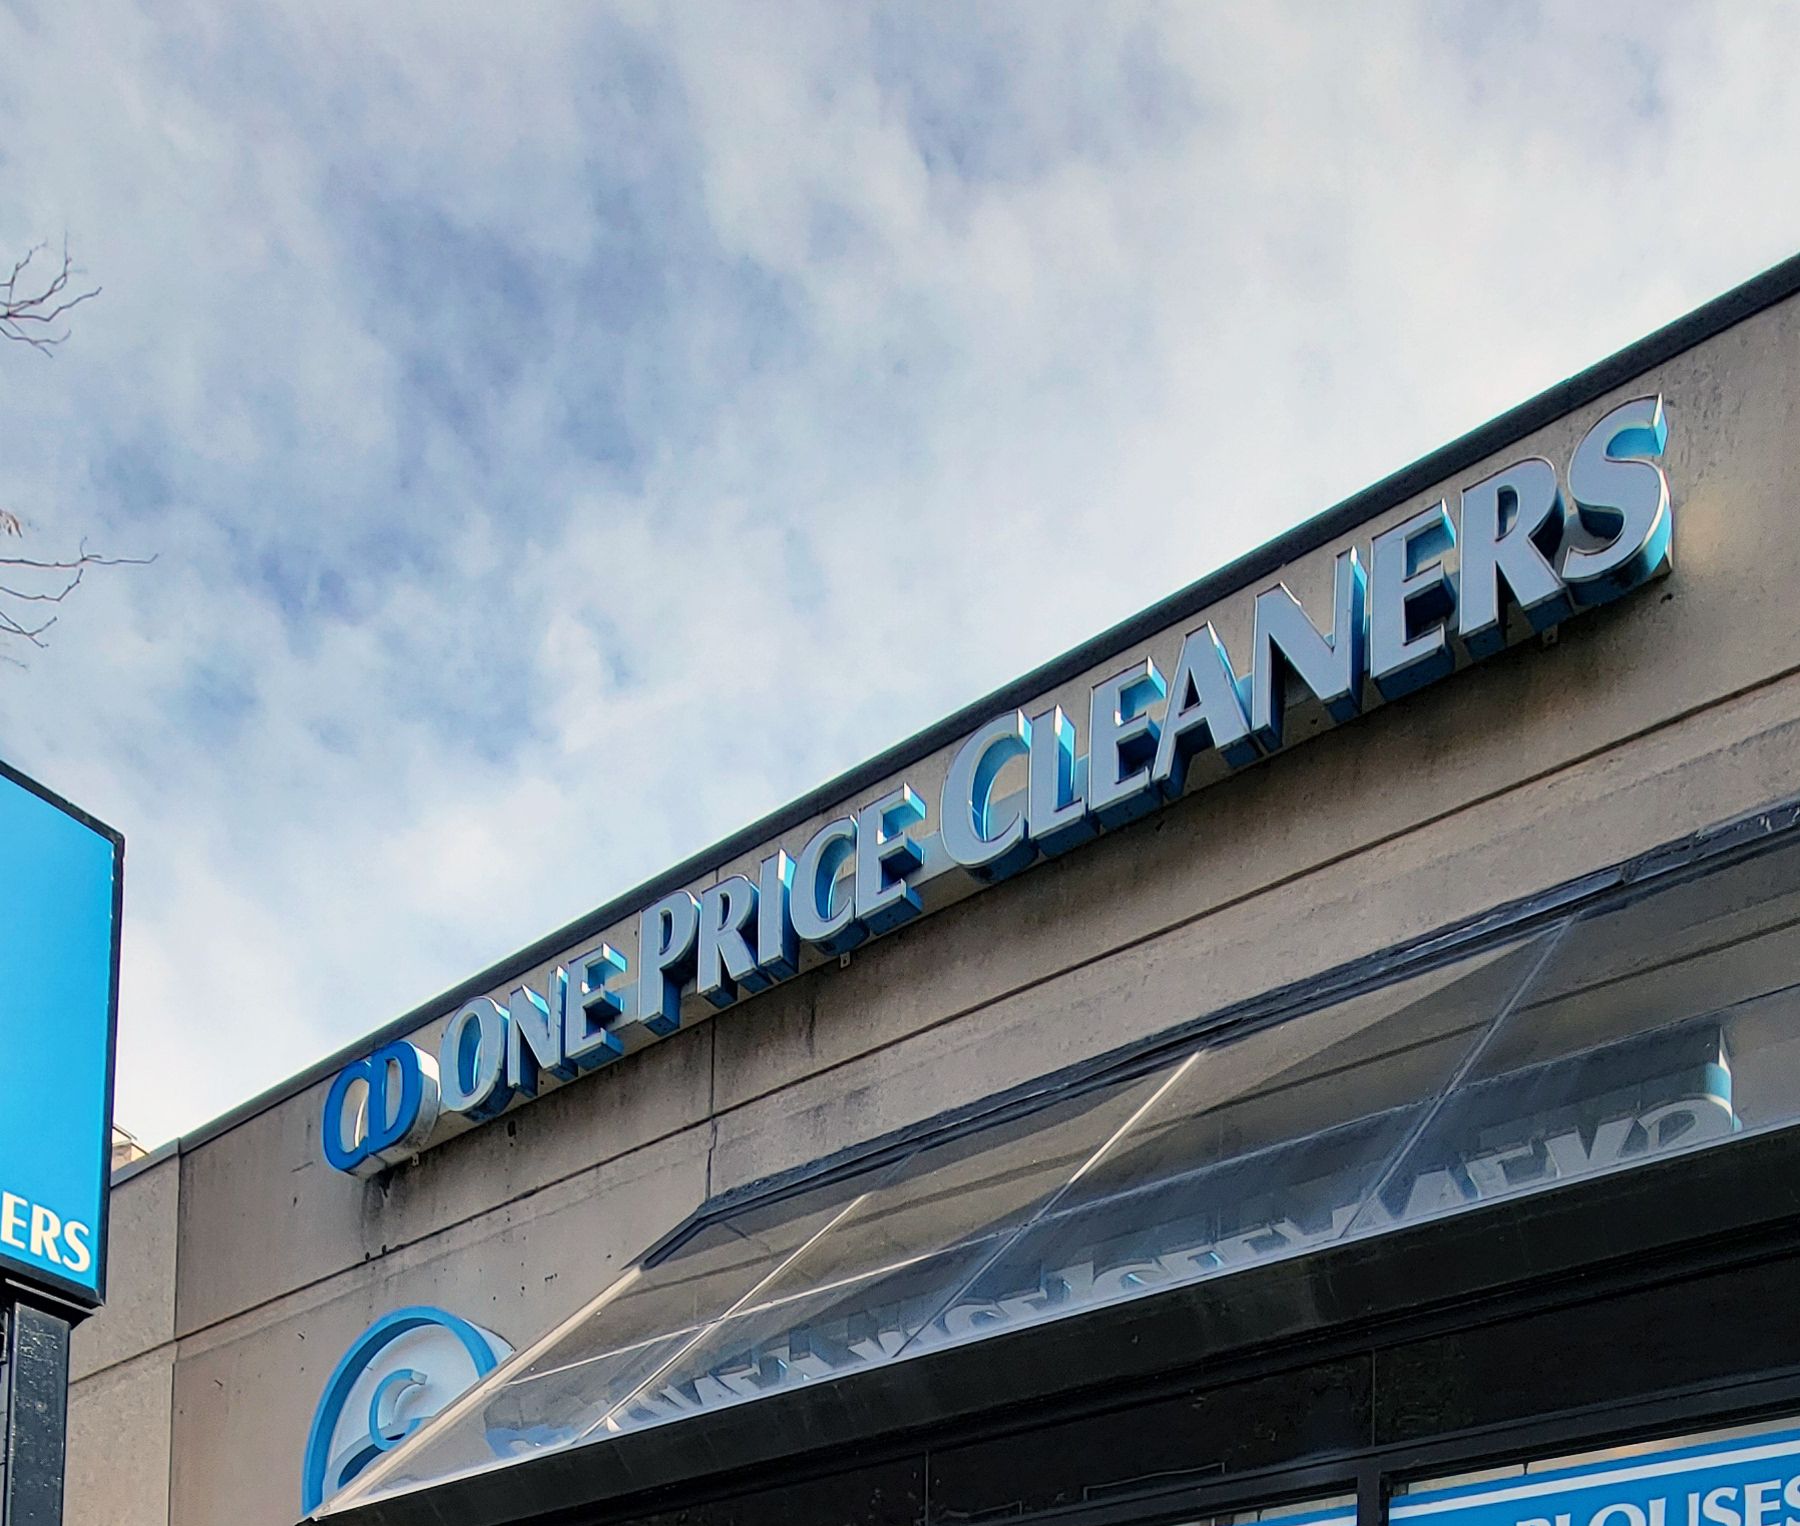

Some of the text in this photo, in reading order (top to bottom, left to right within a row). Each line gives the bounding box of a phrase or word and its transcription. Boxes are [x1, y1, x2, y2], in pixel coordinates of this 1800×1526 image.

[440, 943, 627, 1121] ONE
[637, 783, 926, 1036] PRICE
[940, 393, 1673, 884] CLEANERS
[1, 1190, 92, 1273] ERS
